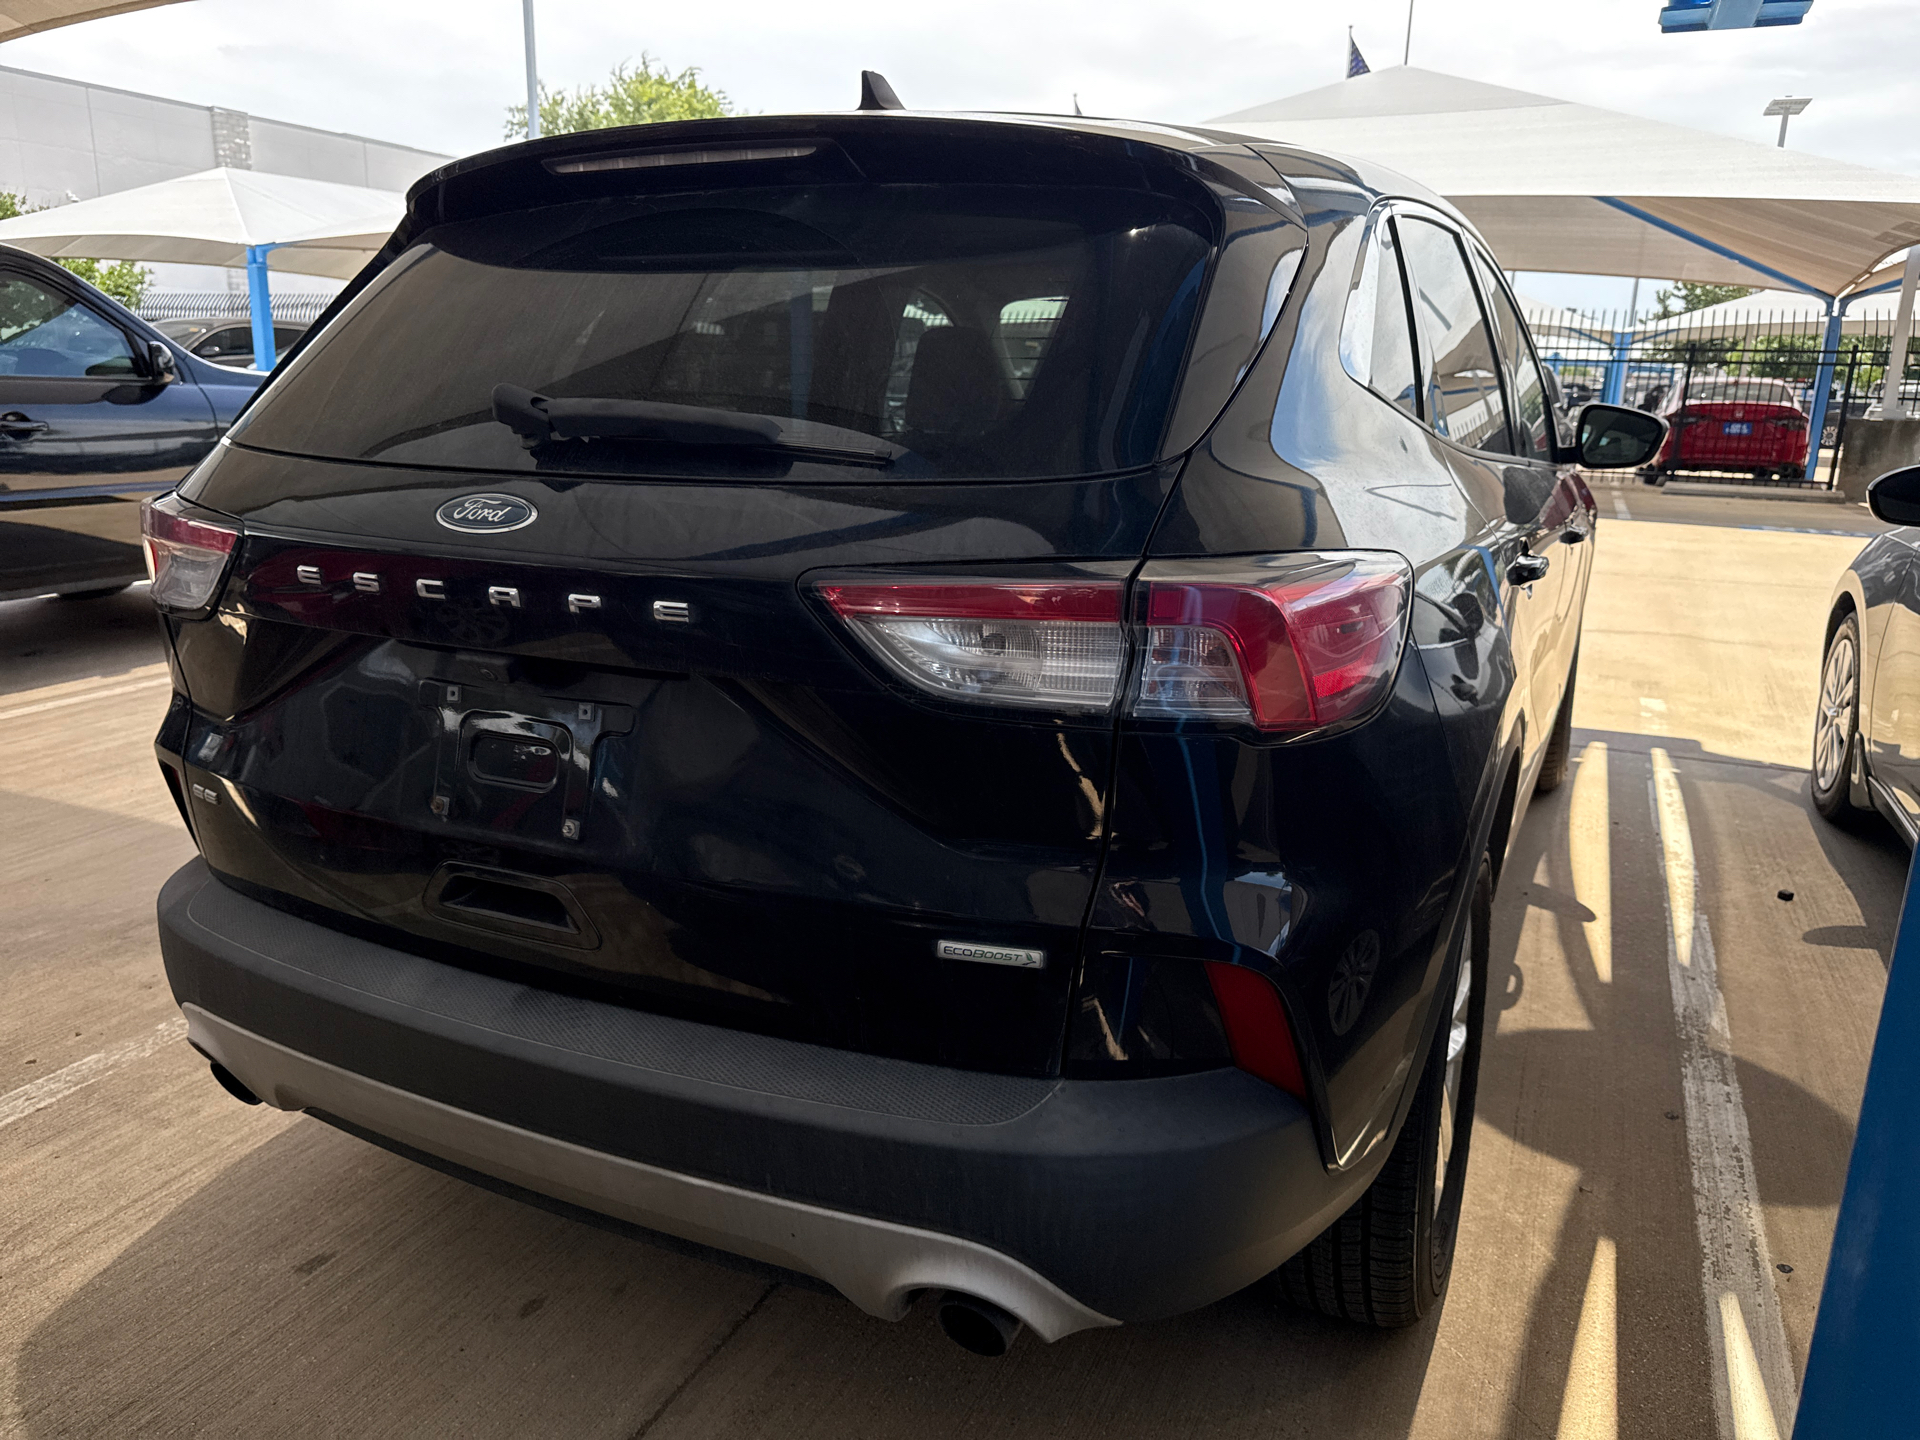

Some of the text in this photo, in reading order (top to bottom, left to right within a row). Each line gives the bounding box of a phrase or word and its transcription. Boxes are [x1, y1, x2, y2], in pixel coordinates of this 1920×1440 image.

[453, 498, 513, 522] Ford
[297, 564, 691, 623] ESCAPE
[943, 945, 1023, 962] ECOBOOST
